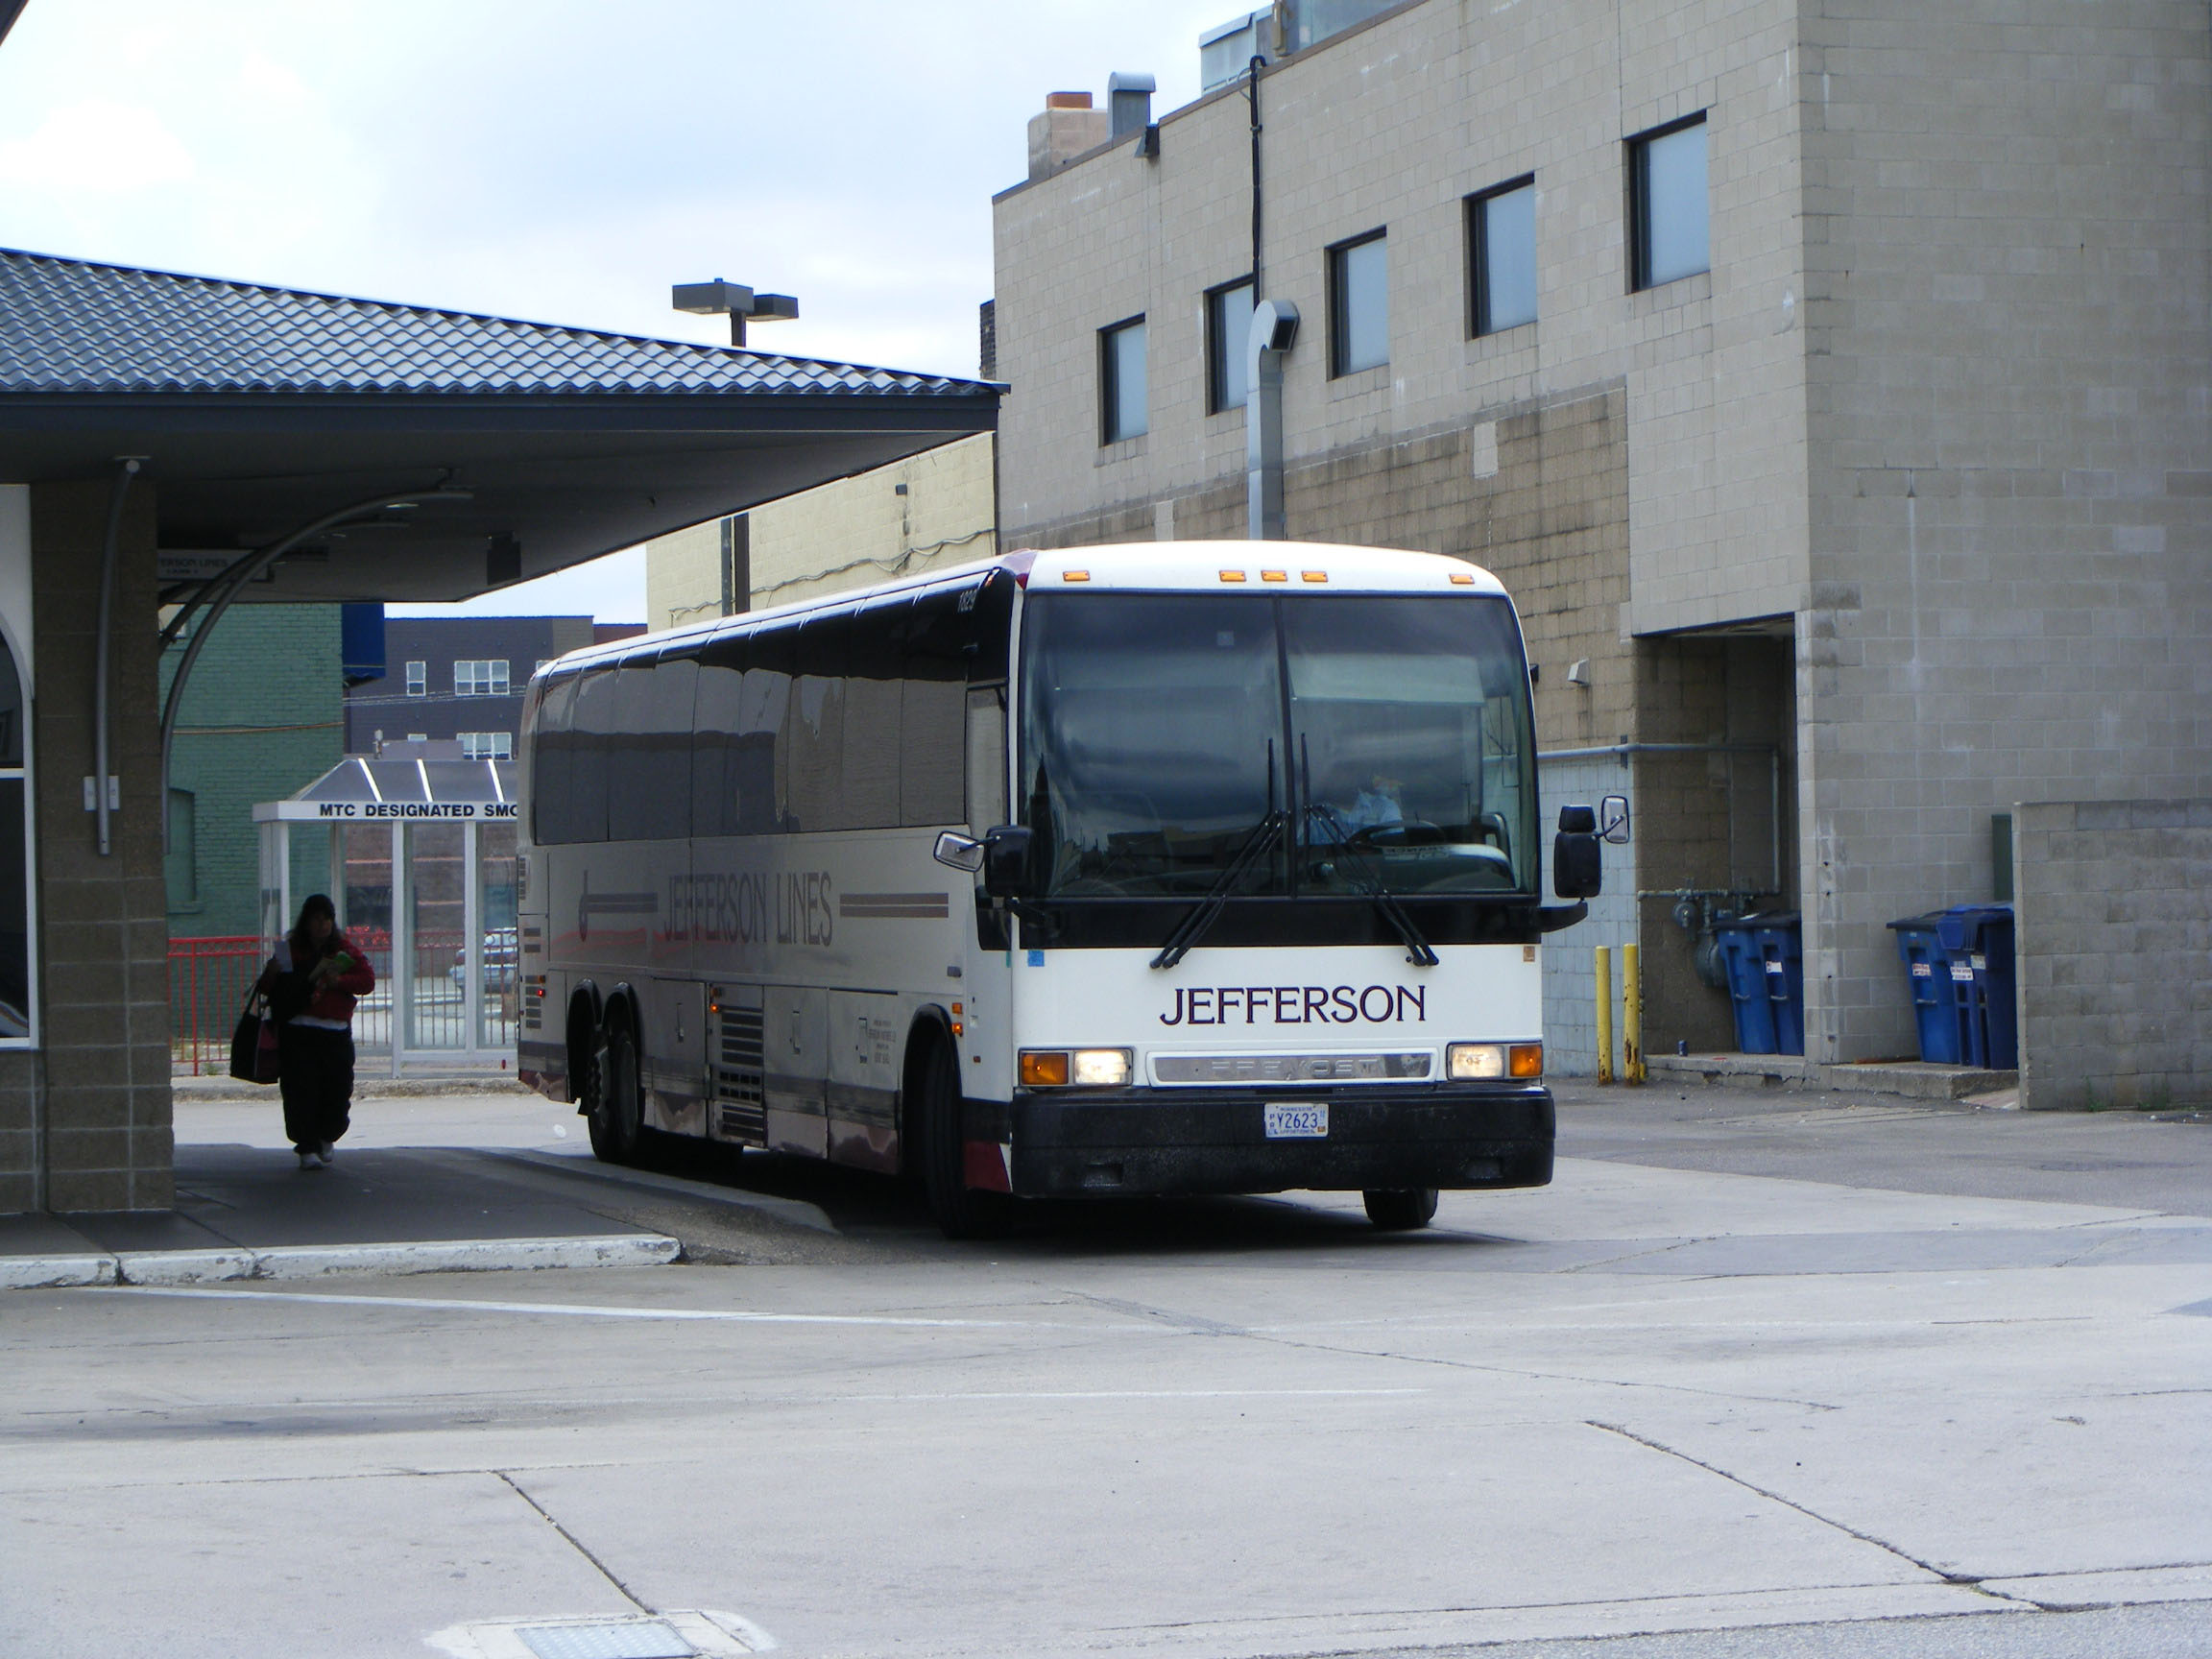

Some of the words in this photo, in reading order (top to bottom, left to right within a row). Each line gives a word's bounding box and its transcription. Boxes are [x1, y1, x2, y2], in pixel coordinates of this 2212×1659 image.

[319, 804, 355, 816] MTC
[365, 804, 475, 817] DESIGNATED
[664, 872, 768, 945] JEFFERSON
[776, 871, 833, 947] LINES
[1159, 984, 1427, 1026] JEFFERSON
[1277, 1112, 1318, 1129] Y2623
